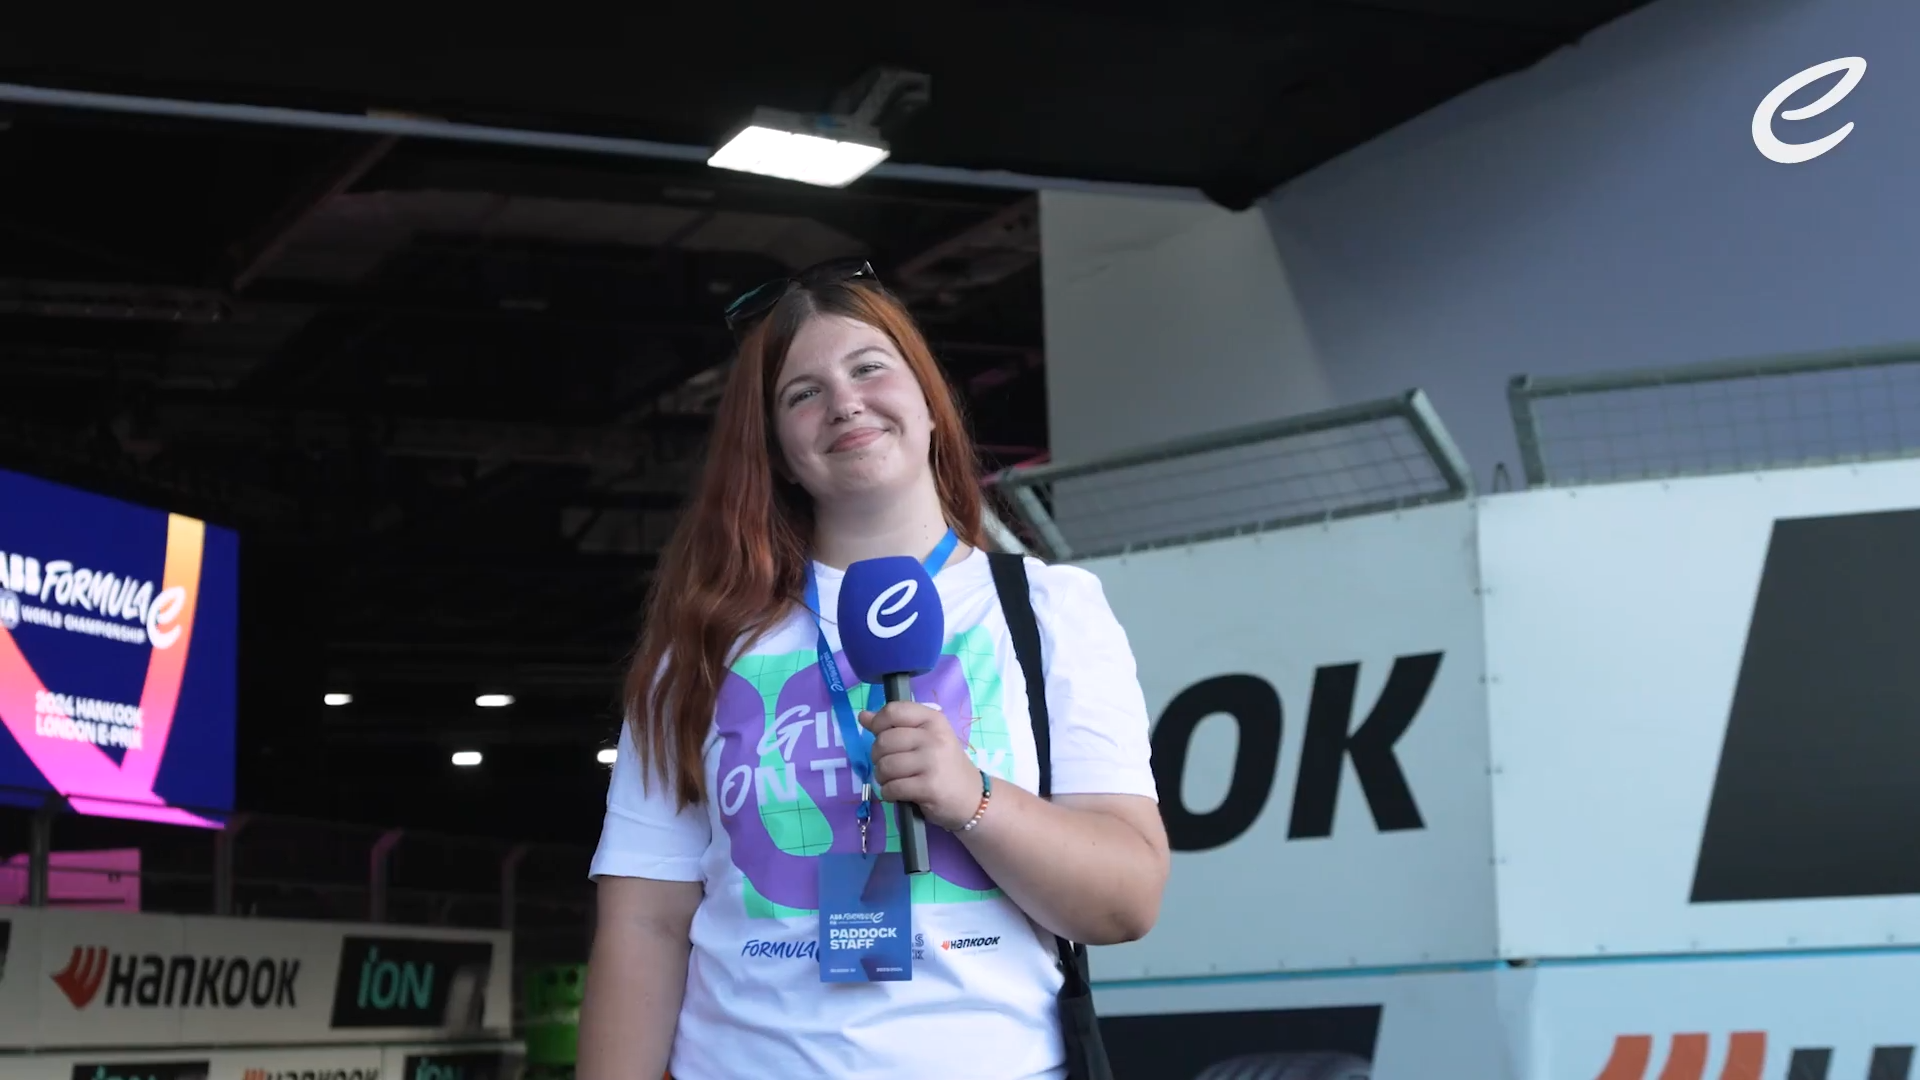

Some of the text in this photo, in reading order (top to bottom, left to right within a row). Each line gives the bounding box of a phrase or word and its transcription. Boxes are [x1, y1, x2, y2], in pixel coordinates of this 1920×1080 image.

[41, 560, 154, 625] FORMULA
[21, 604, 63, 629] WORLD
[64, 613, 147, 645] CHAMPIONSHIP
[35, 690, 144, 729] 2024 HANKOOK
[35, 713, 97, 745] LONDON
[721, 763, 798, 816] ON
[741, 939, 817, 959] FORMULA
[830, 927, 897, 939] PADDOCK
[830, 939, 875, 950] STAFF
